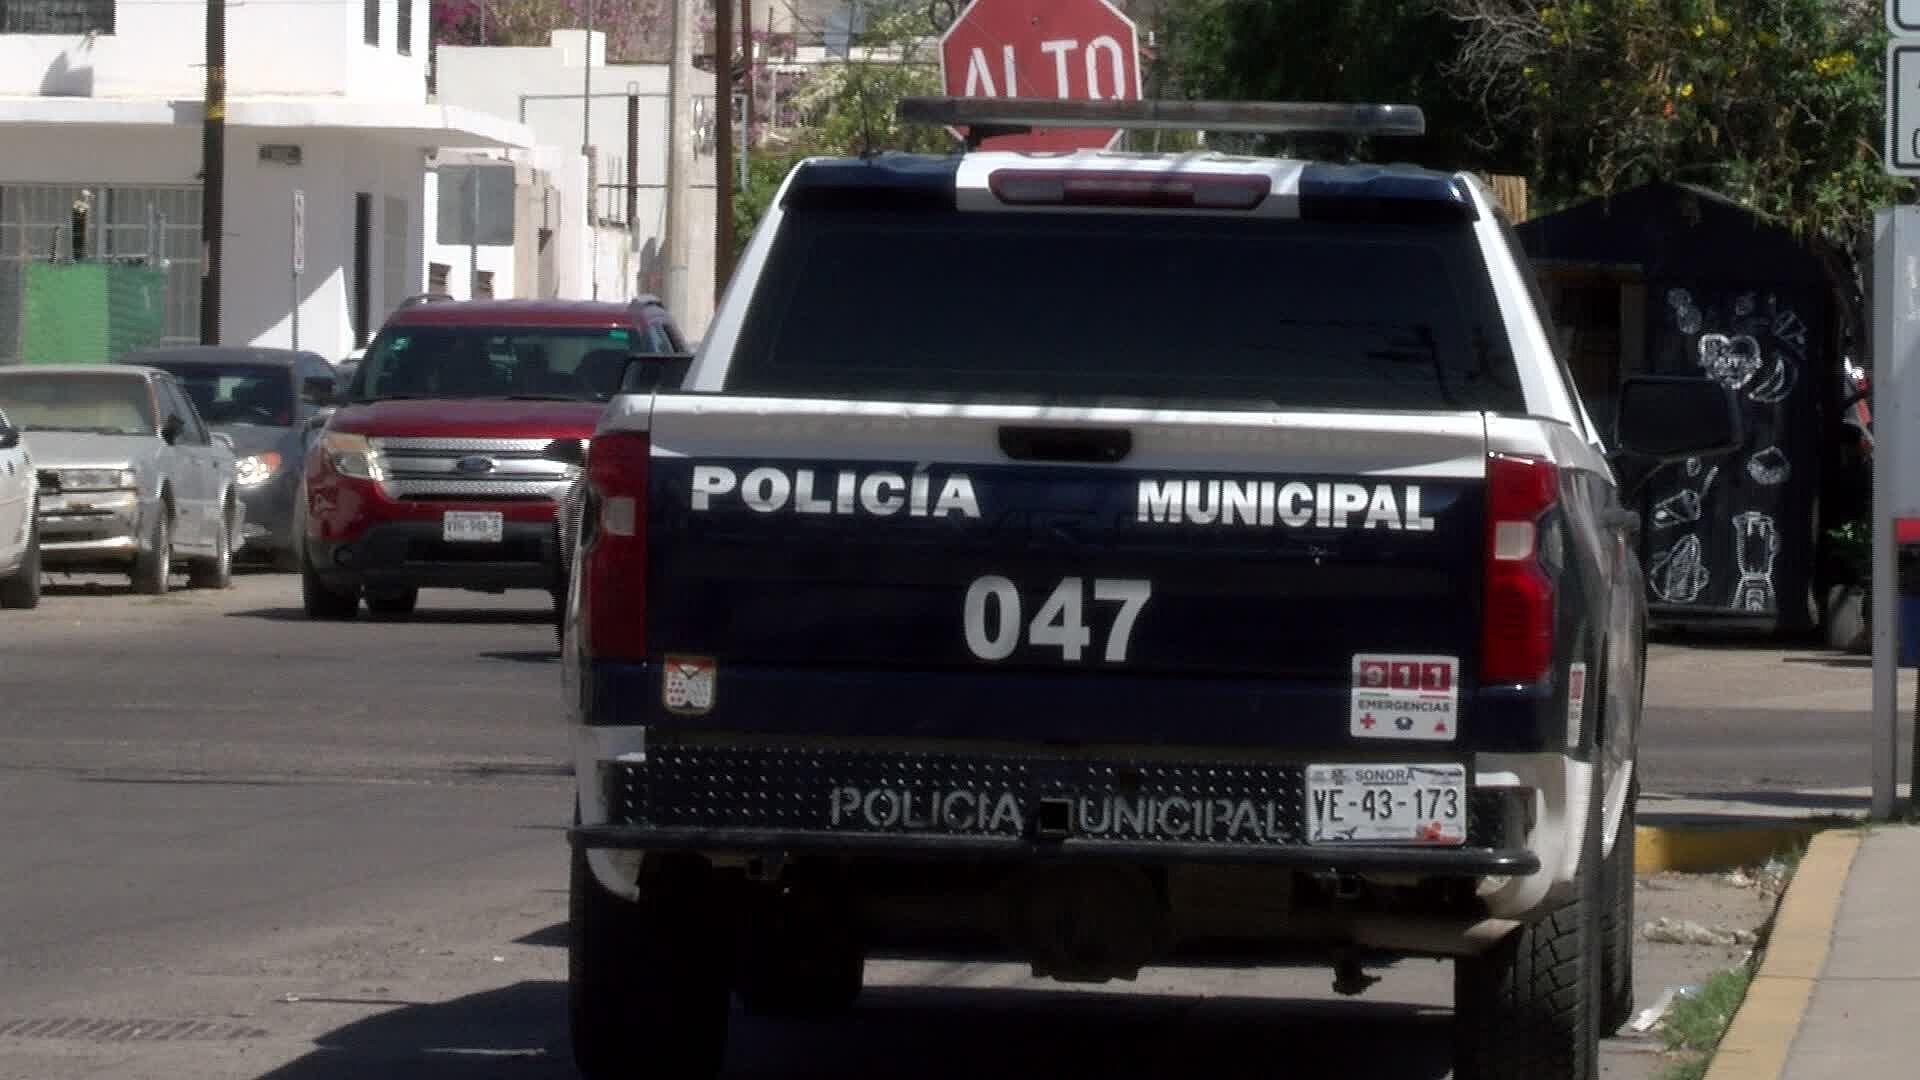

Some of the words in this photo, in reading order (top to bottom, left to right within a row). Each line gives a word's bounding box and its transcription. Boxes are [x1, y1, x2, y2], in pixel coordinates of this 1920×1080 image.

[691, 462, 982, 518] POLICÍA
[1137, 479, 1435, 530] MUNICIPAL
[964, 574, 1152, 663] 047
[1366, 664, 1444, 689] 911
[1358, 699, 1450, 713] EMERGENCIAS
[1355, 769, 1416, 782] SONORA
[830, 787, 1024, 831] POLICIA
[1313, 788, 1458, 822] VE-43-173
